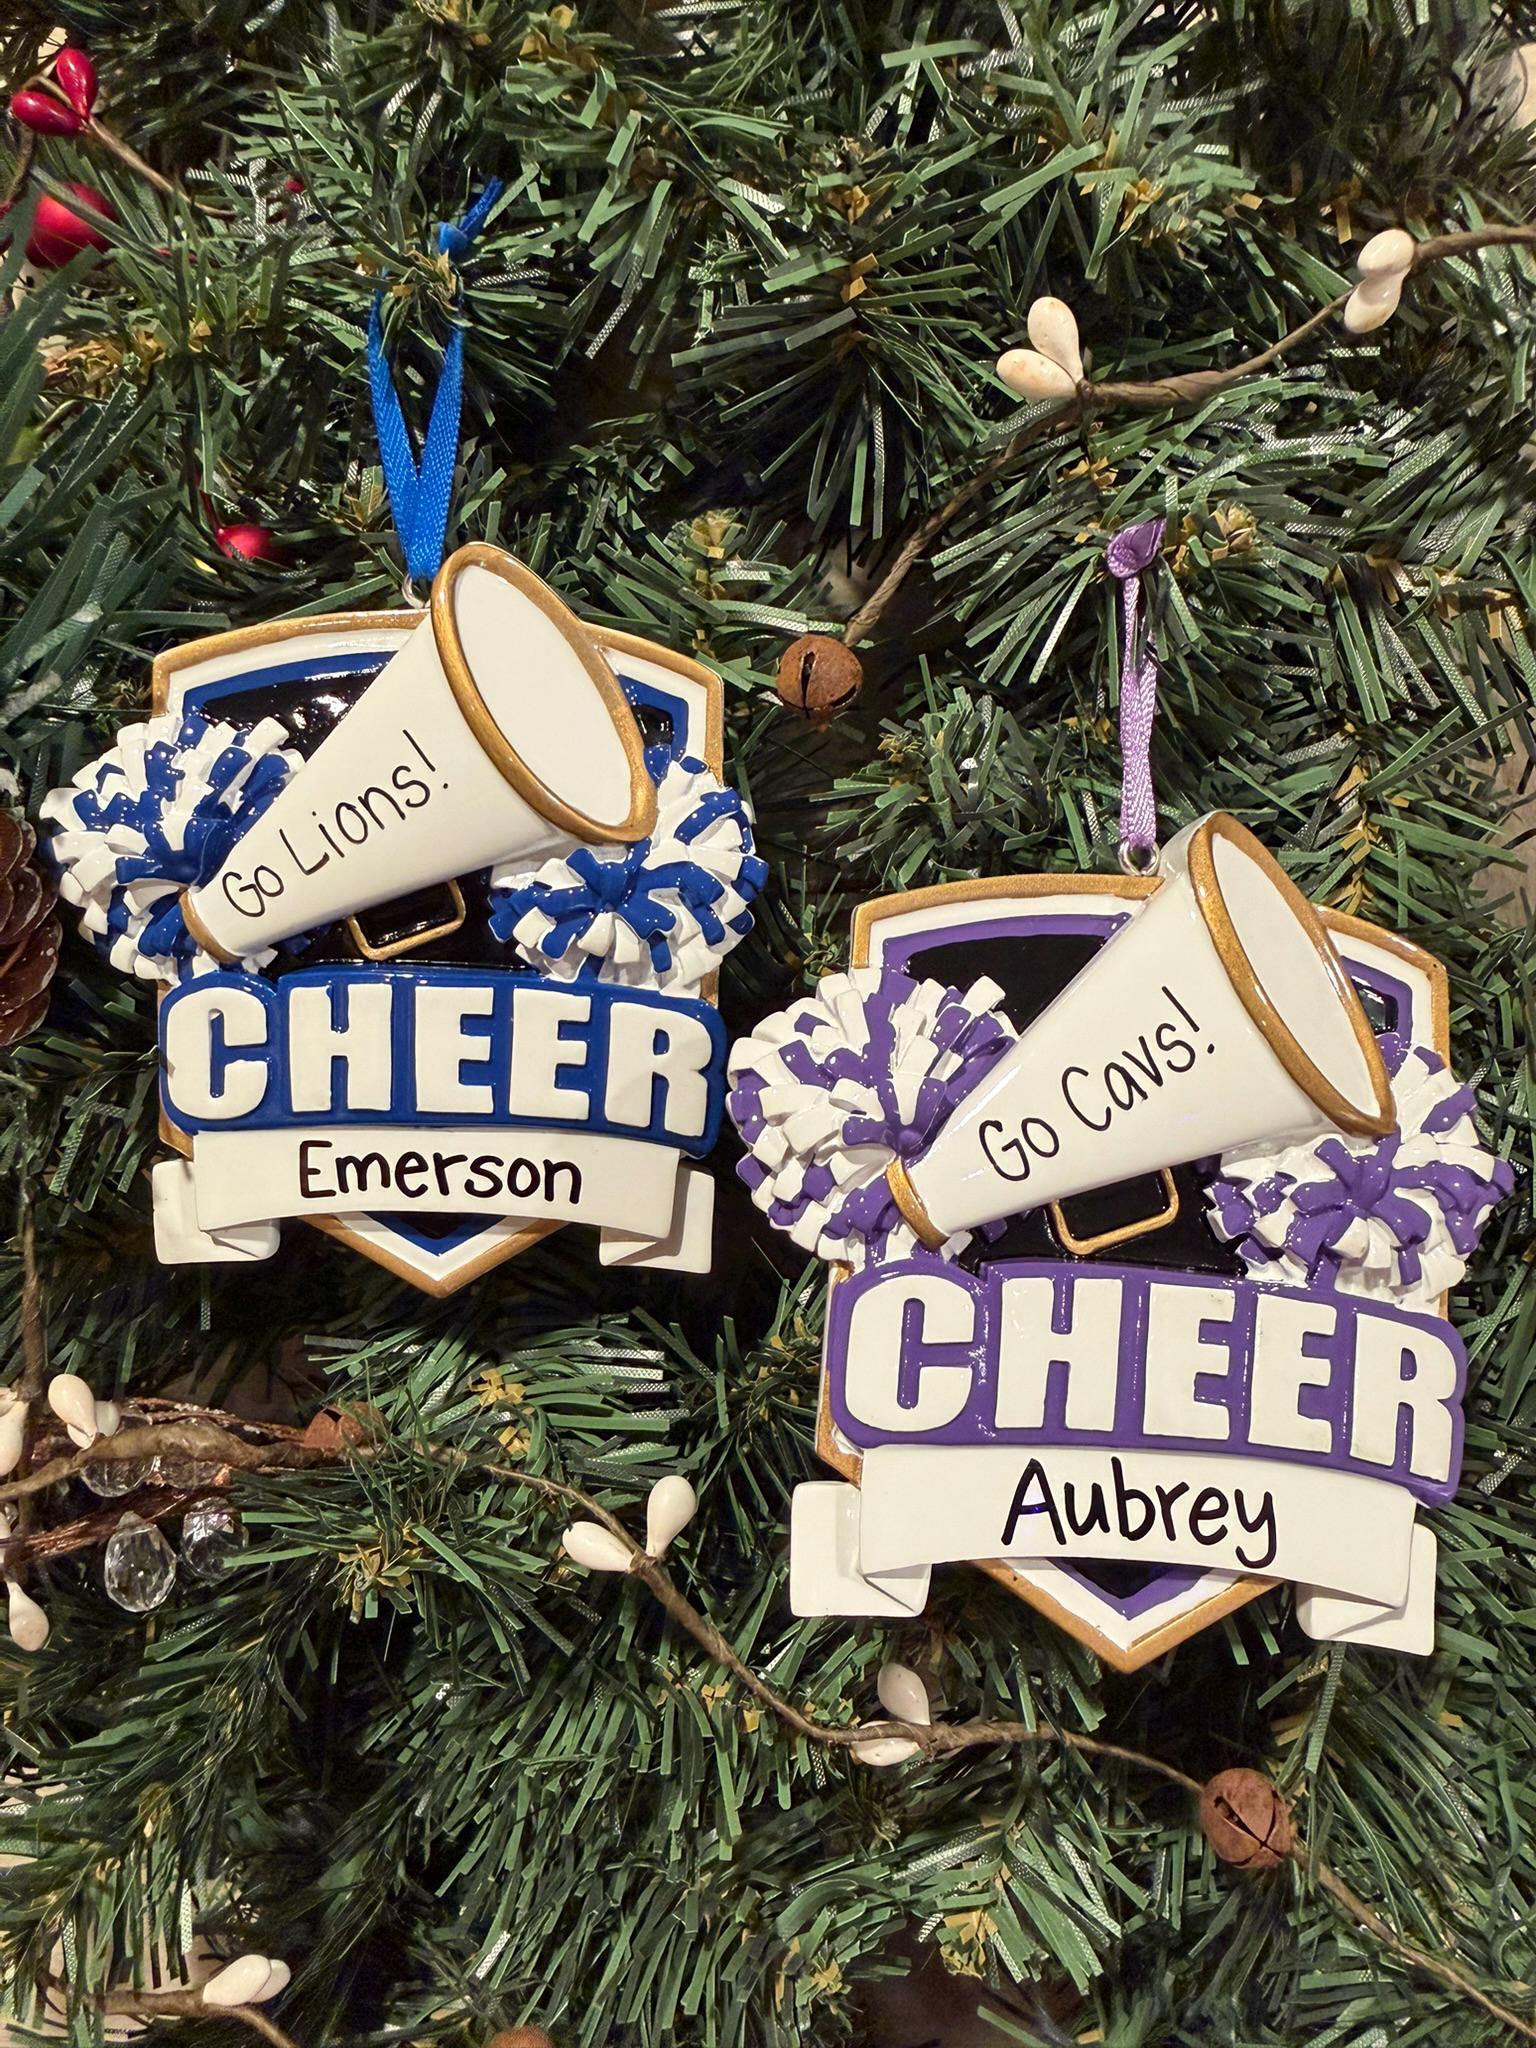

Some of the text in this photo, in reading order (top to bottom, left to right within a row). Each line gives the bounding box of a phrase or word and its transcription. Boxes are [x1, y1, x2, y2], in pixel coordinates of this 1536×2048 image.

[222, 729, 449, 919] Go Lions!
[166, 984, 712, 1137] CHEER
[977, 986, 1216, 1183] Go Cavs!
[299, 1140, 583, 1204] Emerson
[844, 1274, 1461, 1483] CHEER
[1000, 1456, 1279, 1569] Aubrey
